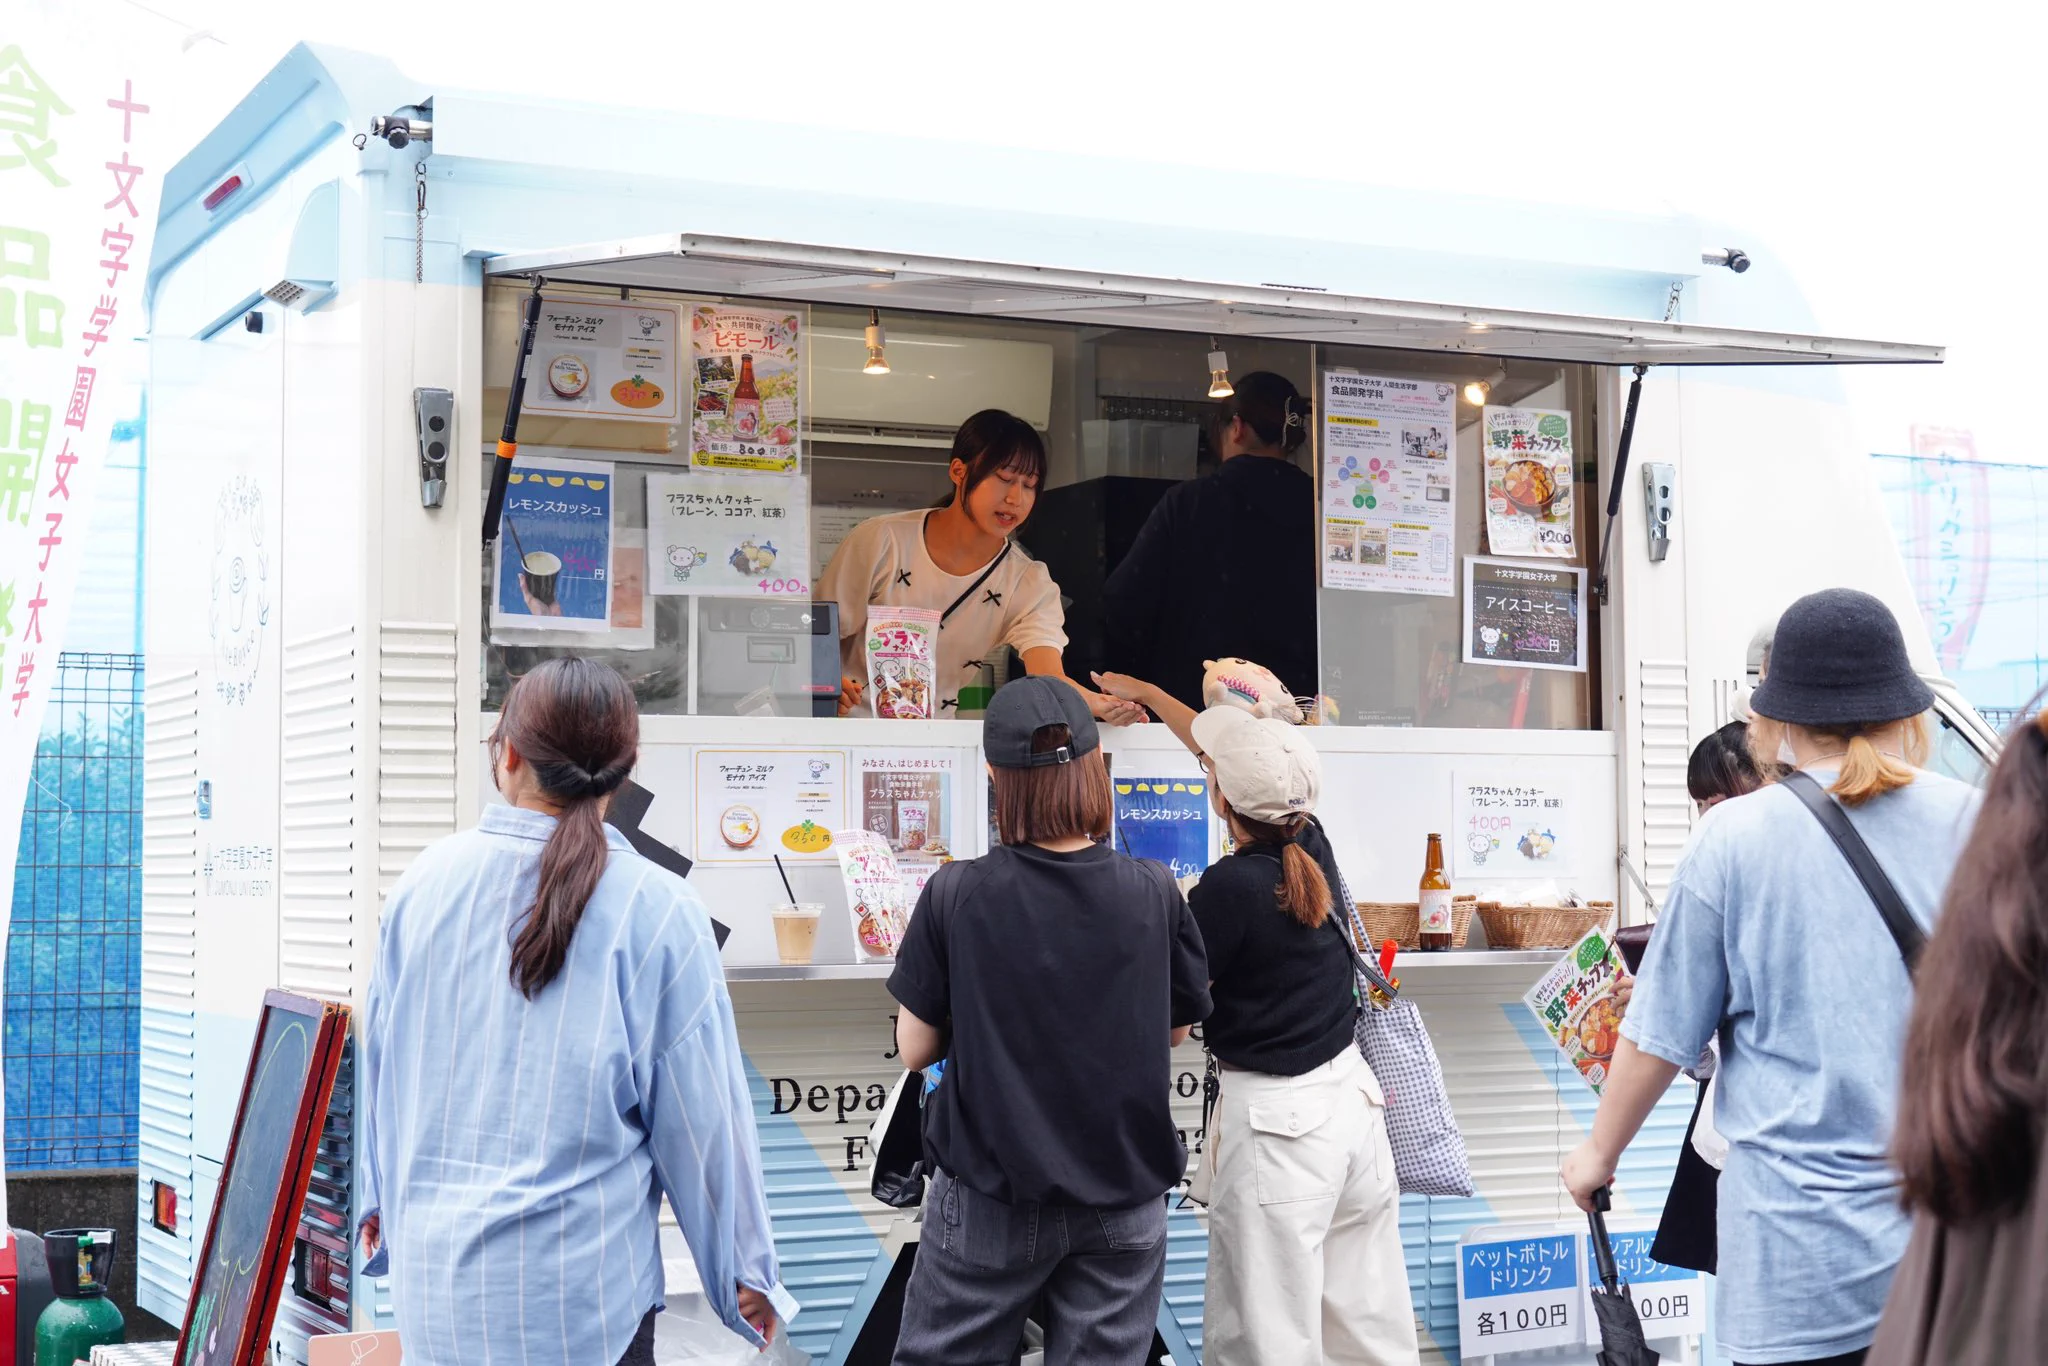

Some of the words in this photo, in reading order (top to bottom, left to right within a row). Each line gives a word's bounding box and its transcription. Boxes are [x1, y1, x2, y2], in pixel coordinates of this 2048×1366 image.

[554, 323, 574, 332] モナカ
[577, 325, 597, 334] アイス
[584, 316, 604, 326] ミルク
[731, 321, 762, 331] 共同開発
[714, 330, 781, 350] ピモール
[1328, 376, 1381, 387] 十文字学園女子大学
[1383, 381, 1418, 391] 人間生活学部
[1331, 385, 1384, 399] 食品開発学科
[12, 79, 150, 717] 十文字学園女子大学
[1491, 428, 1563, 454] 野菜チップス
[508, 497, 603, 516] レモンスカッシュ
[1494, 568, 1558, 583] 十文字学園女子大学
[1485, 595, 1568, 614] アイスコーヒー
[719, 765, 753, 773] フォーチュン
[755, 765, 775, 773] ミルク
[1120, 808, 1203, 820] レモンスカッシュ
[1545, 962, 1614, 1028] 野菜チップス
[769, 1077, 887, 1124] Depa
[1470, 1240, 1569, 1268] ペットボトル
[1491, 1265, 1552, 1291] ドリンク
[1477, 1303, 1568, 1336] 各100円
